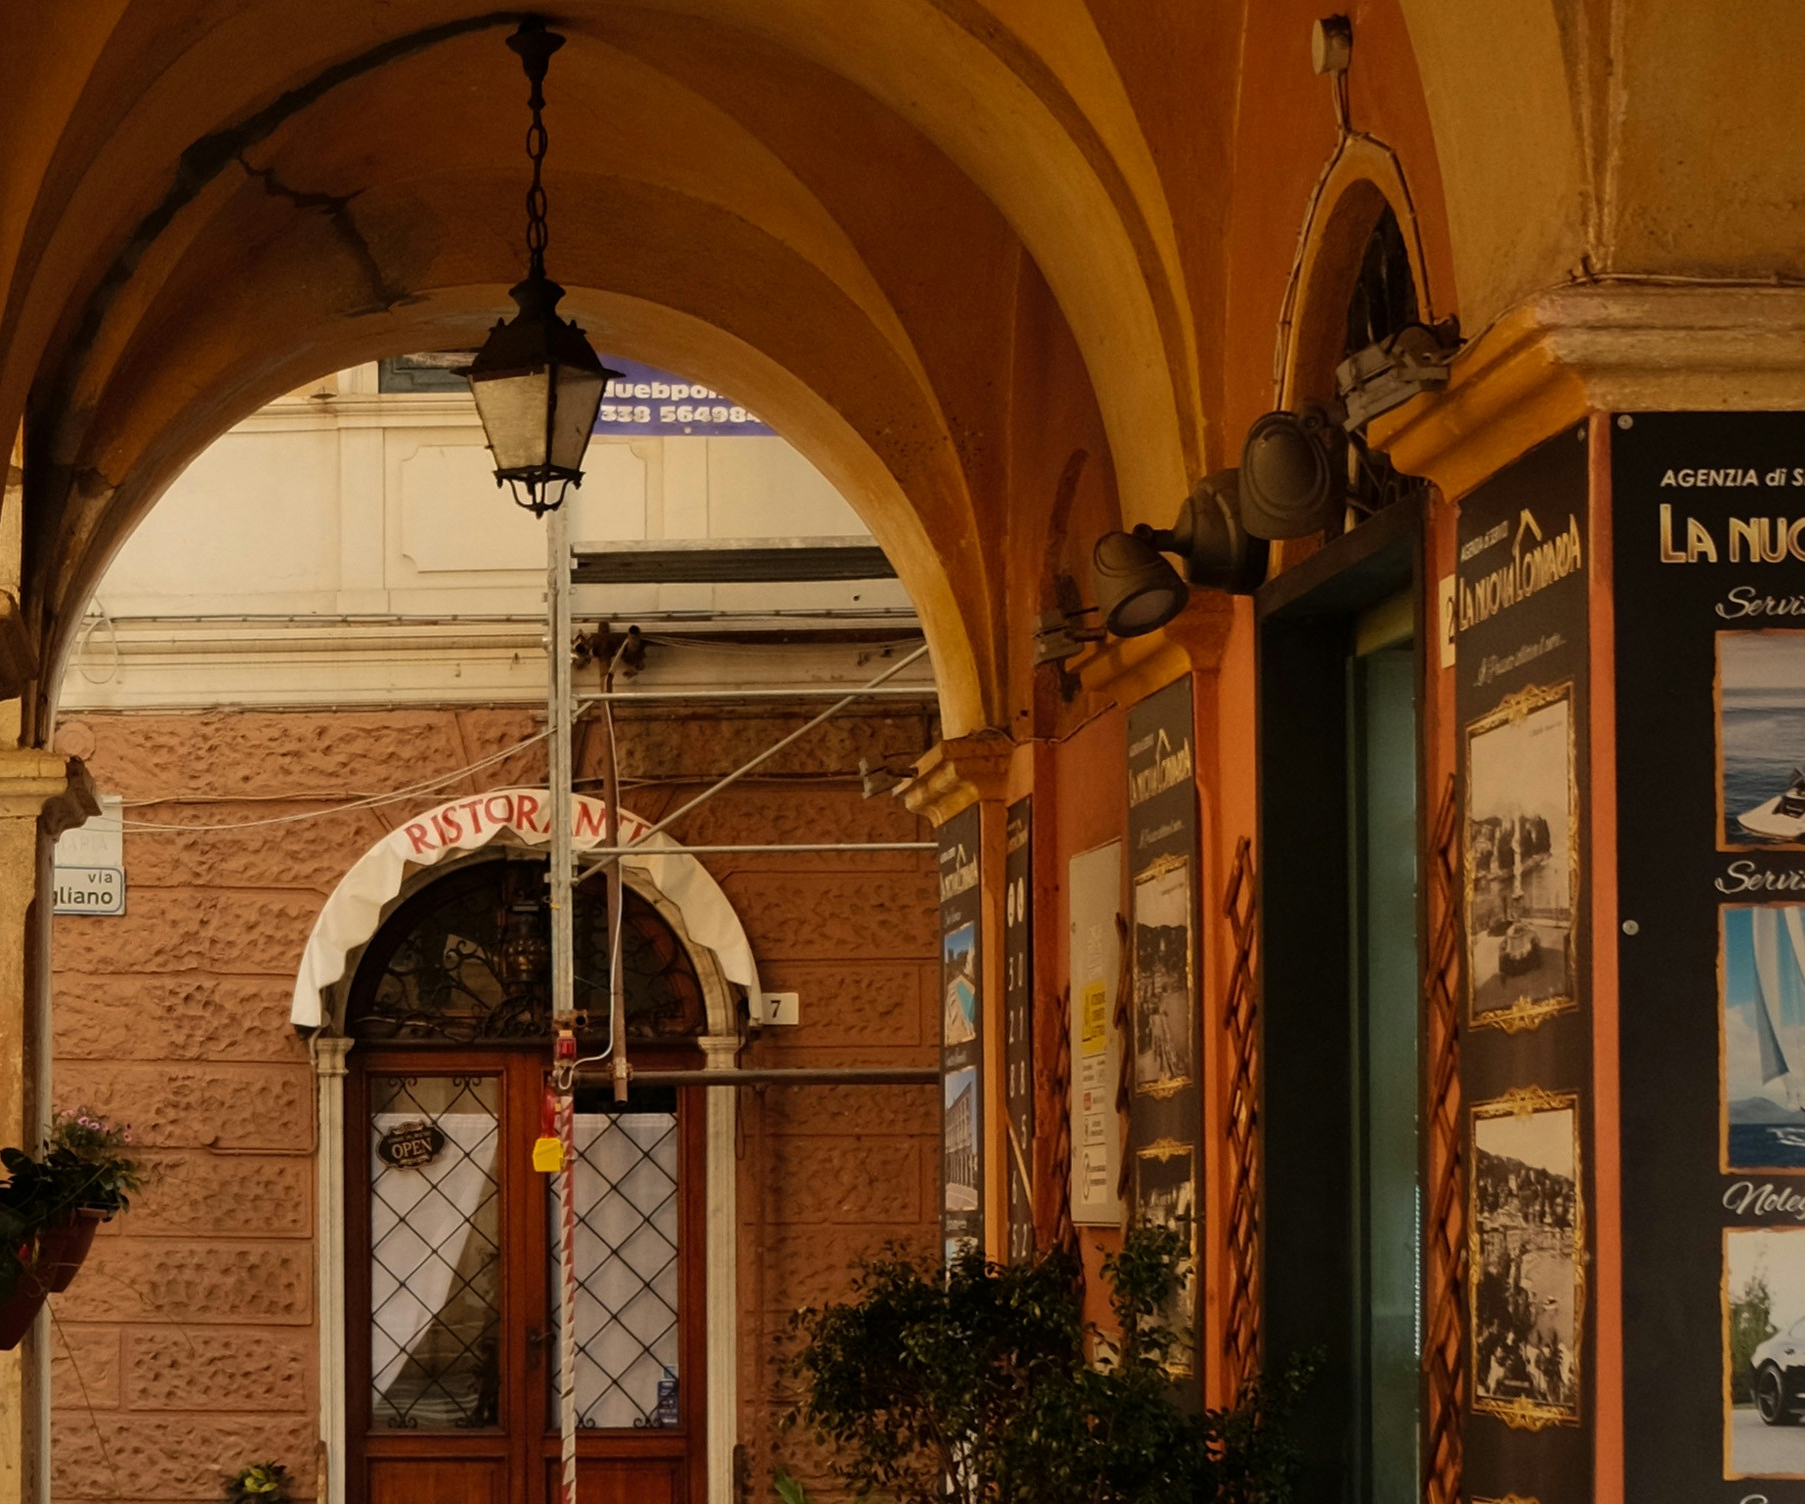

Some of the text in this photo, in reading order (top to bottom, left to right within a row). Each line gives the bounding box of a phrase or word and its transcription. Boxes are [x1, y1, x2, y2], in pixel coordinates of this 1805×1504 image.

[1660, 469, 1759, 487] AGENZIA
[1765, 468, 1788, 486] di
[1659, 503, 1718, 563] LA
[88, 871, 113, 884] via
[770, 999, 781, 1019] 7
[391, 1137, 433, 1160] OPEN
